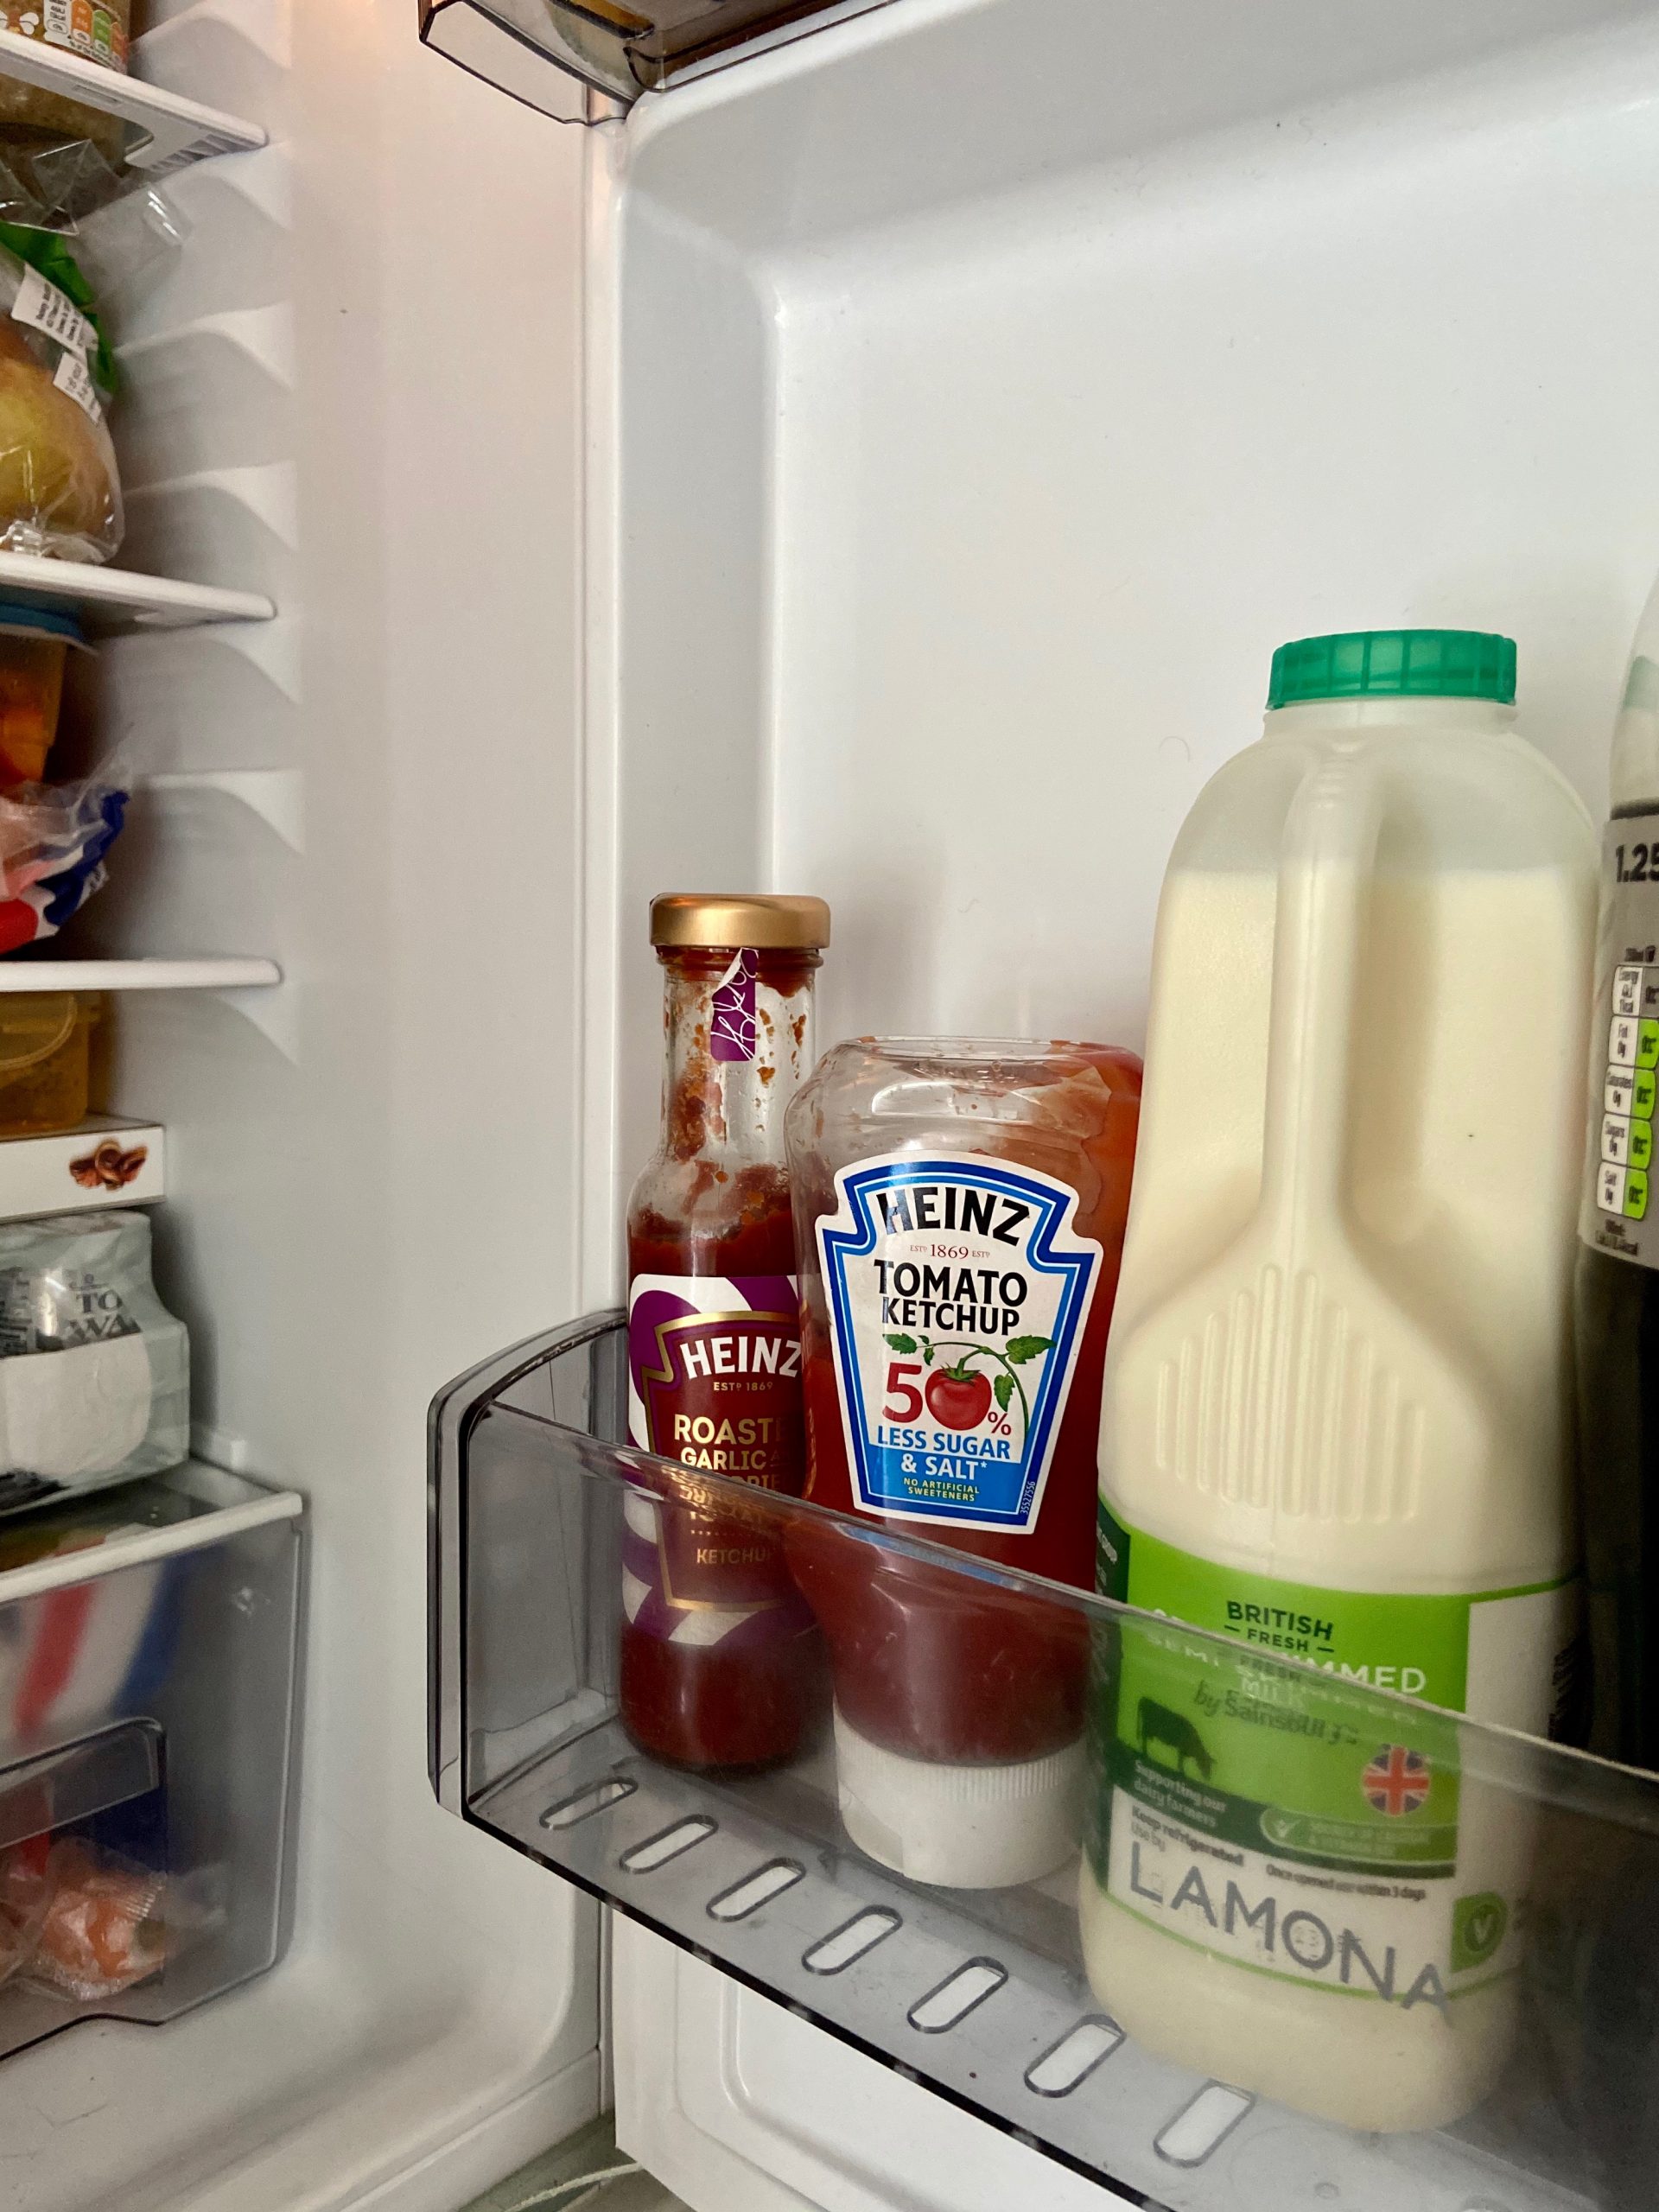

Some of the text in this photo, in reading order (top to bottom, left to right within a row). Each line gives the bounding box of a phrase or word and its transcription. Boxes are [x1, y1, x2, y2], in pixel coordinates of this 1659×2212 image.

[876, 1186, 1030, 1247] HEINZ
[931, 1243, 969, 1260] 1869
[874, 1259, 1028, 1307] TOMATO
[882, 1296, 1020, 1337] KETCHUP
[679, 1336, 802, 1380] HEINZ
[746, 1381, 773, 1391] 1869
[877, 1425, 1011, 1460] LESS SUGAR
[681, 1446, 767, 1471] GARLIC
[900, 1452, 918, 1474] &
[904, 1478, 980, 1494] NO ARTIFICIAL
[908, 1486, 976, 1502] SWEETENERS
[1227, 1600, 1334, 1641] BRITISH
[1247, 1628, 1309, 1652] FRESH
[1130, 1841, 1452, 2020] LAMONA
